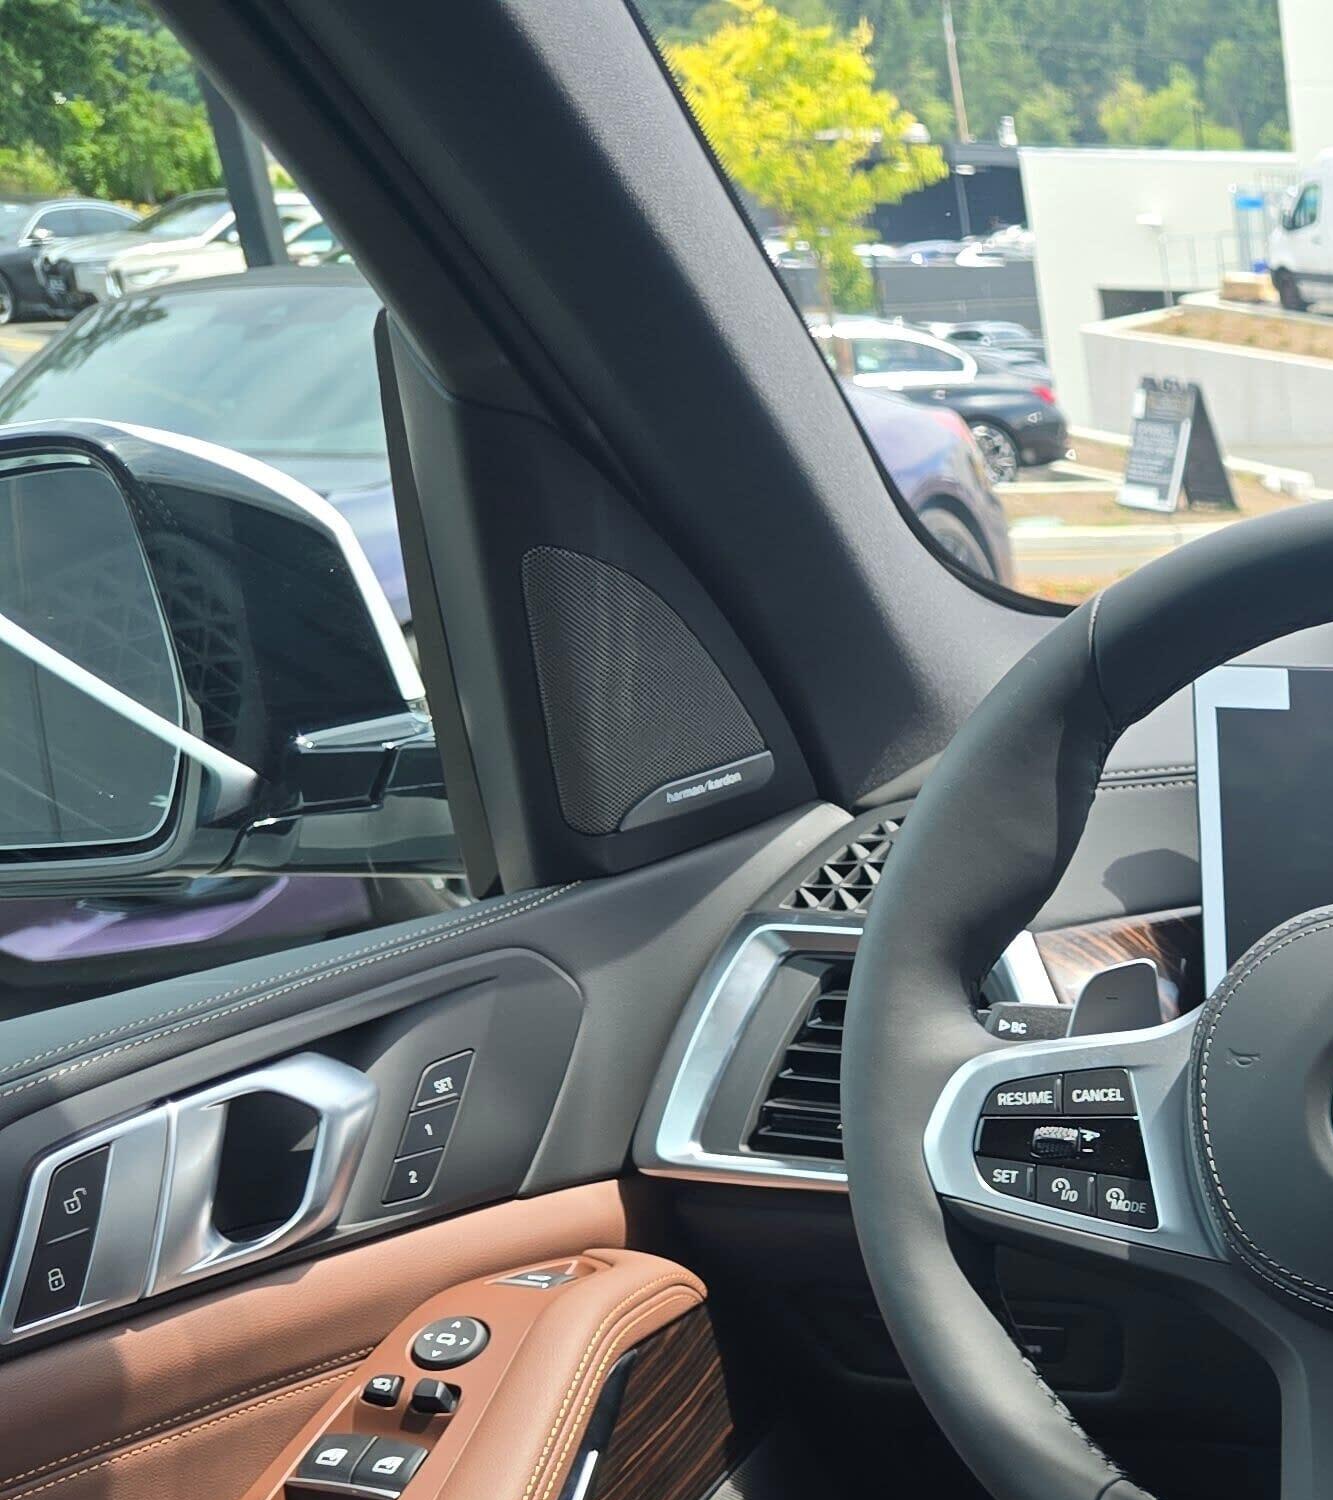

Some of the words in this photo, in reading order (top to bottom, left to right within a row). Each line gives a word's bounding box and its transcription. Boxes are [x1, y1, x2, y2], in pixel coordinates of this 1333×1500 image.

[1010, 1021, 1027, 1035] BC
[433, 1077, 453, 1093] SET
[997, 1090, 1053, 1106] RESUME
[1072, 1088, 1124, 1103] CANCEL
[424, 1123, 433, 1136] 1
[408, 1170, 418, 1183] 2
[992, 1168, 1019, 1184] SET
[1110, 1198, 1147, 1214] MODE
